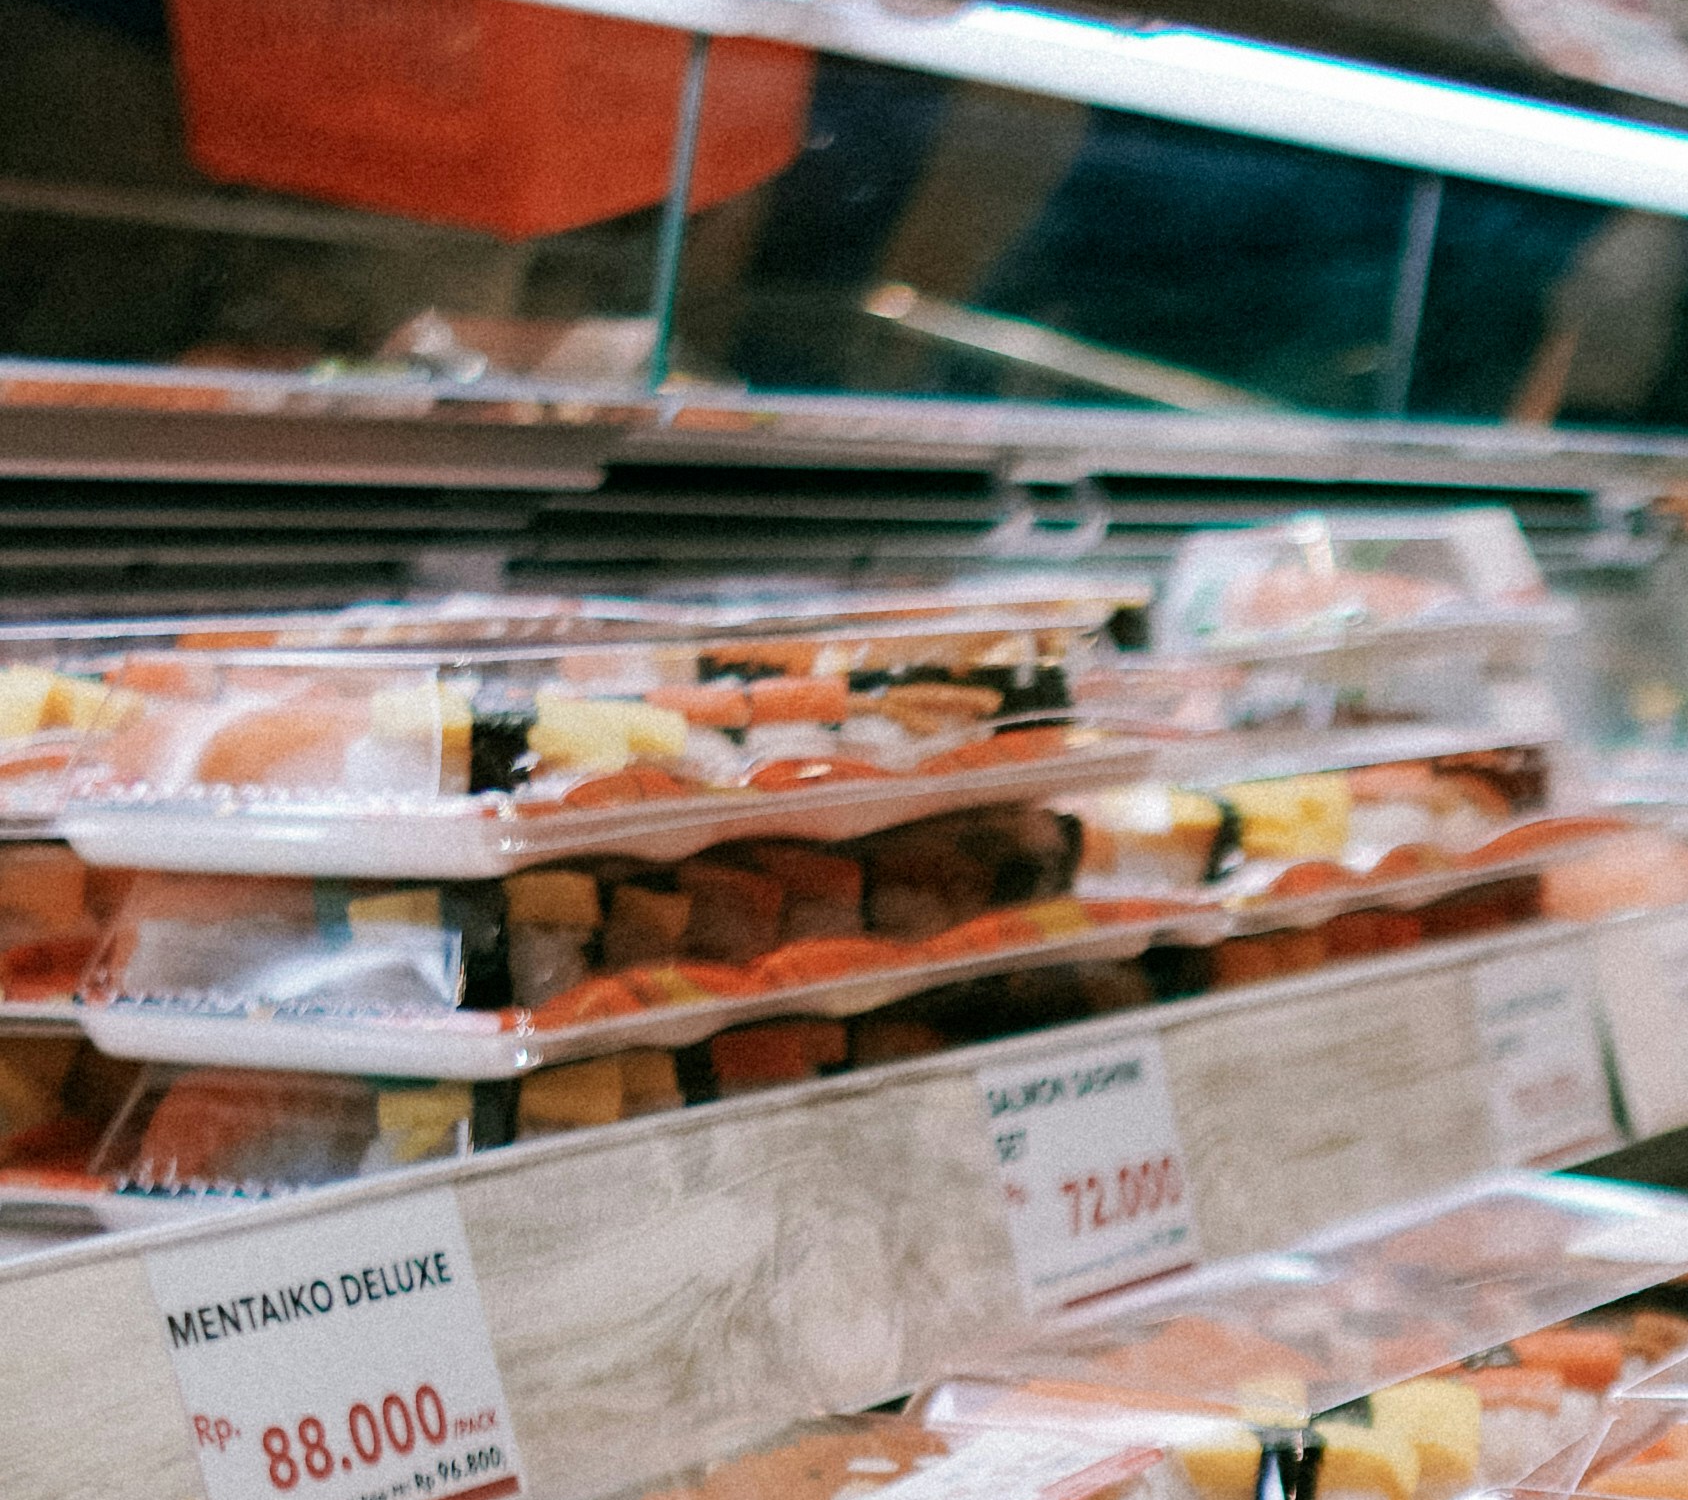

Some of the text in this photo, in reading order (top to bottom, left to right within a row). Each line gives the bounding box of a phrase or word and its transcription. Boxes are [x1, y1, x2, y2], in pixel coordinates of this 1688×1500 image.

[167, 1252, 452, 1349] MENTAIKO DELUXE
[193, 1413, 241, 1451] Rp.
[262, 1383, 448, 1491] 88.000
